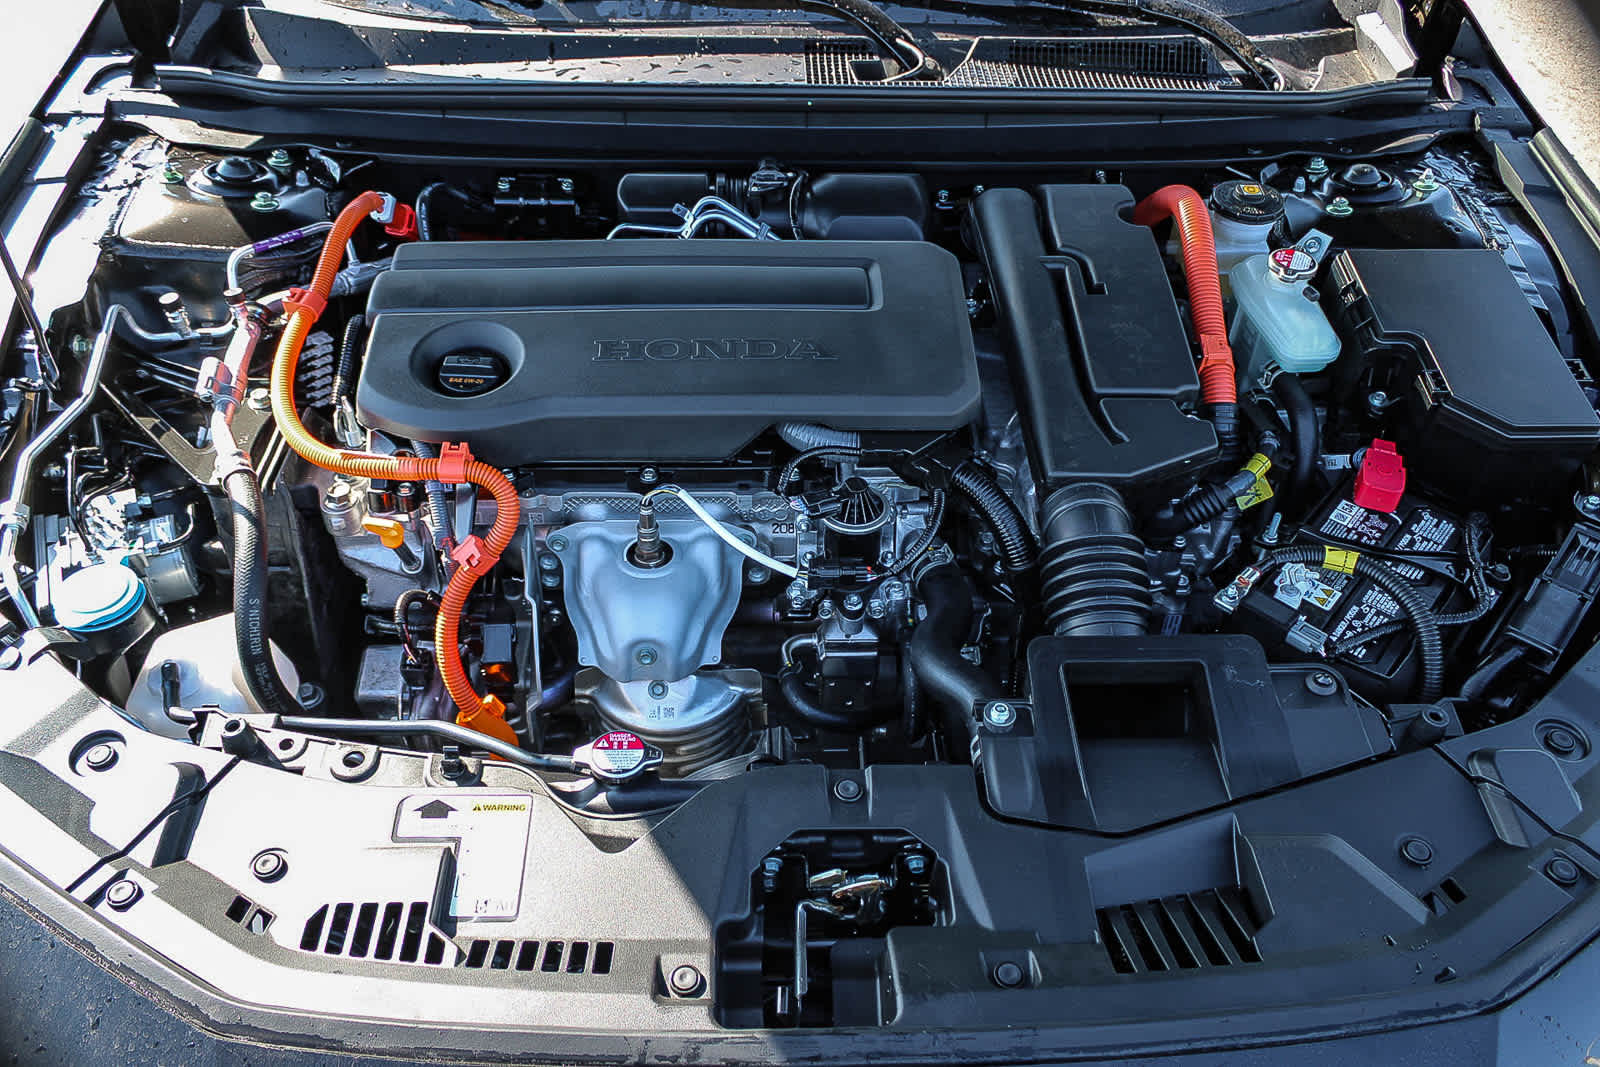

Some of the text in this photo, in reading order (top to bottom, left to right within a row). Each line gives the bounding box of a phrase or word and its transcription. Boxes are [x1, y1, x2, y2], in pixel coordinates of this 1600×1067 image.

[592, 338, 839, 361] HONDA
[772, 523, 795, 534] 208
[249, 609, 264, 655] NICHIRIN
